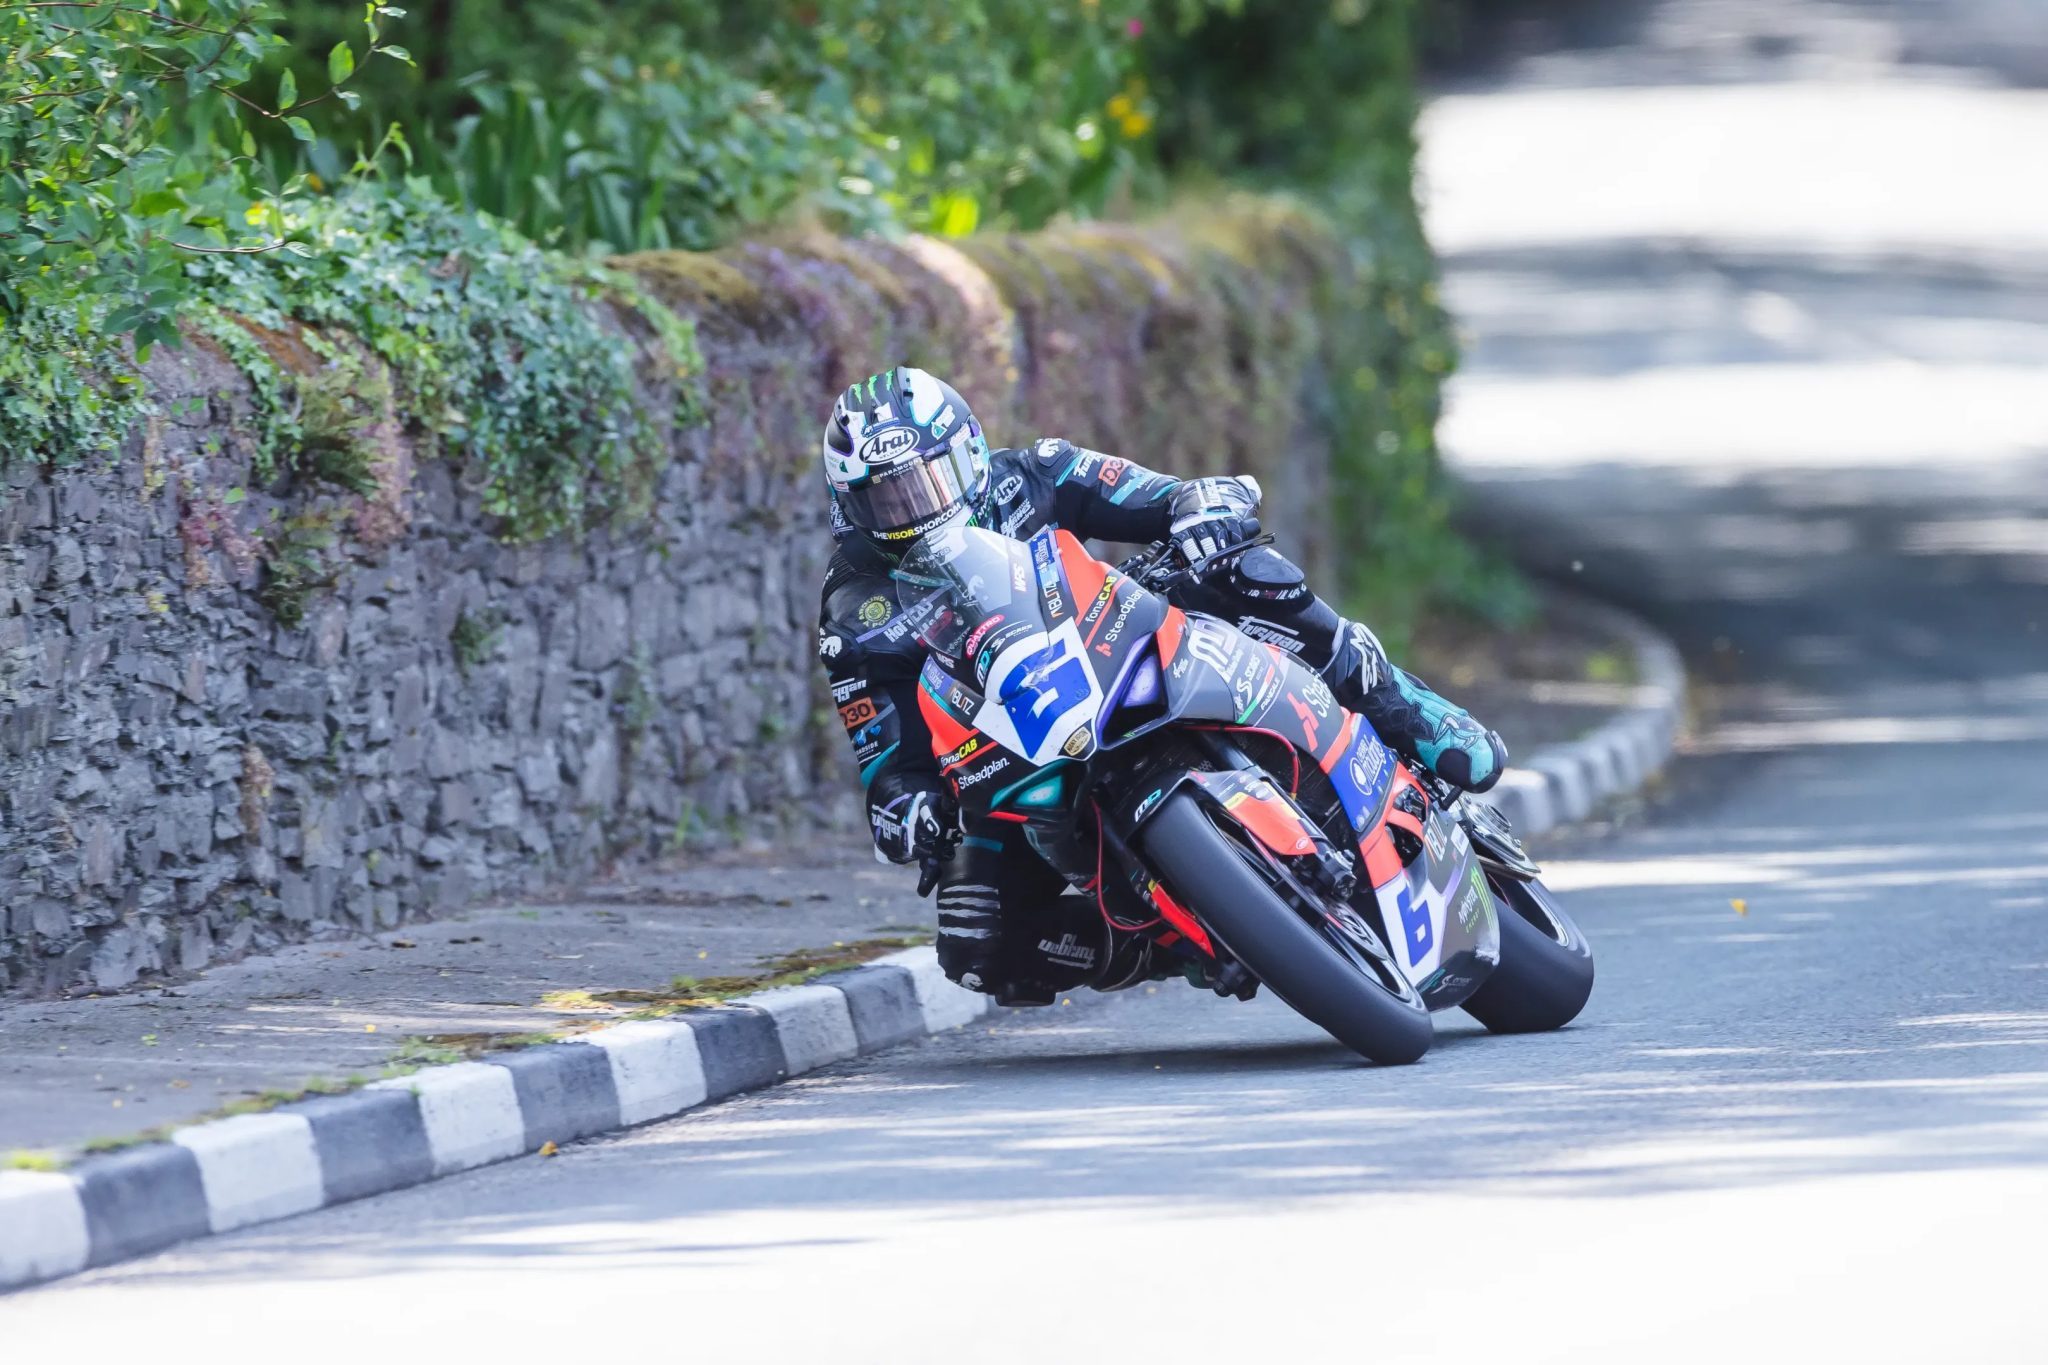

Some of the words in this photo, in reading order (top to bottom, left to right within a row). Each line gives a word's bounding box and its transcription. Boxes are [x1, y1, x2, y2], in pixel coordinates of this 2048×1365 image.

[864, 431, 912, 462] Arai
[996, 475, 1021, 501] Arai
[1085, 575, 1118, 622] fonaCAB
[1397, 885, 1433, 967] 6
